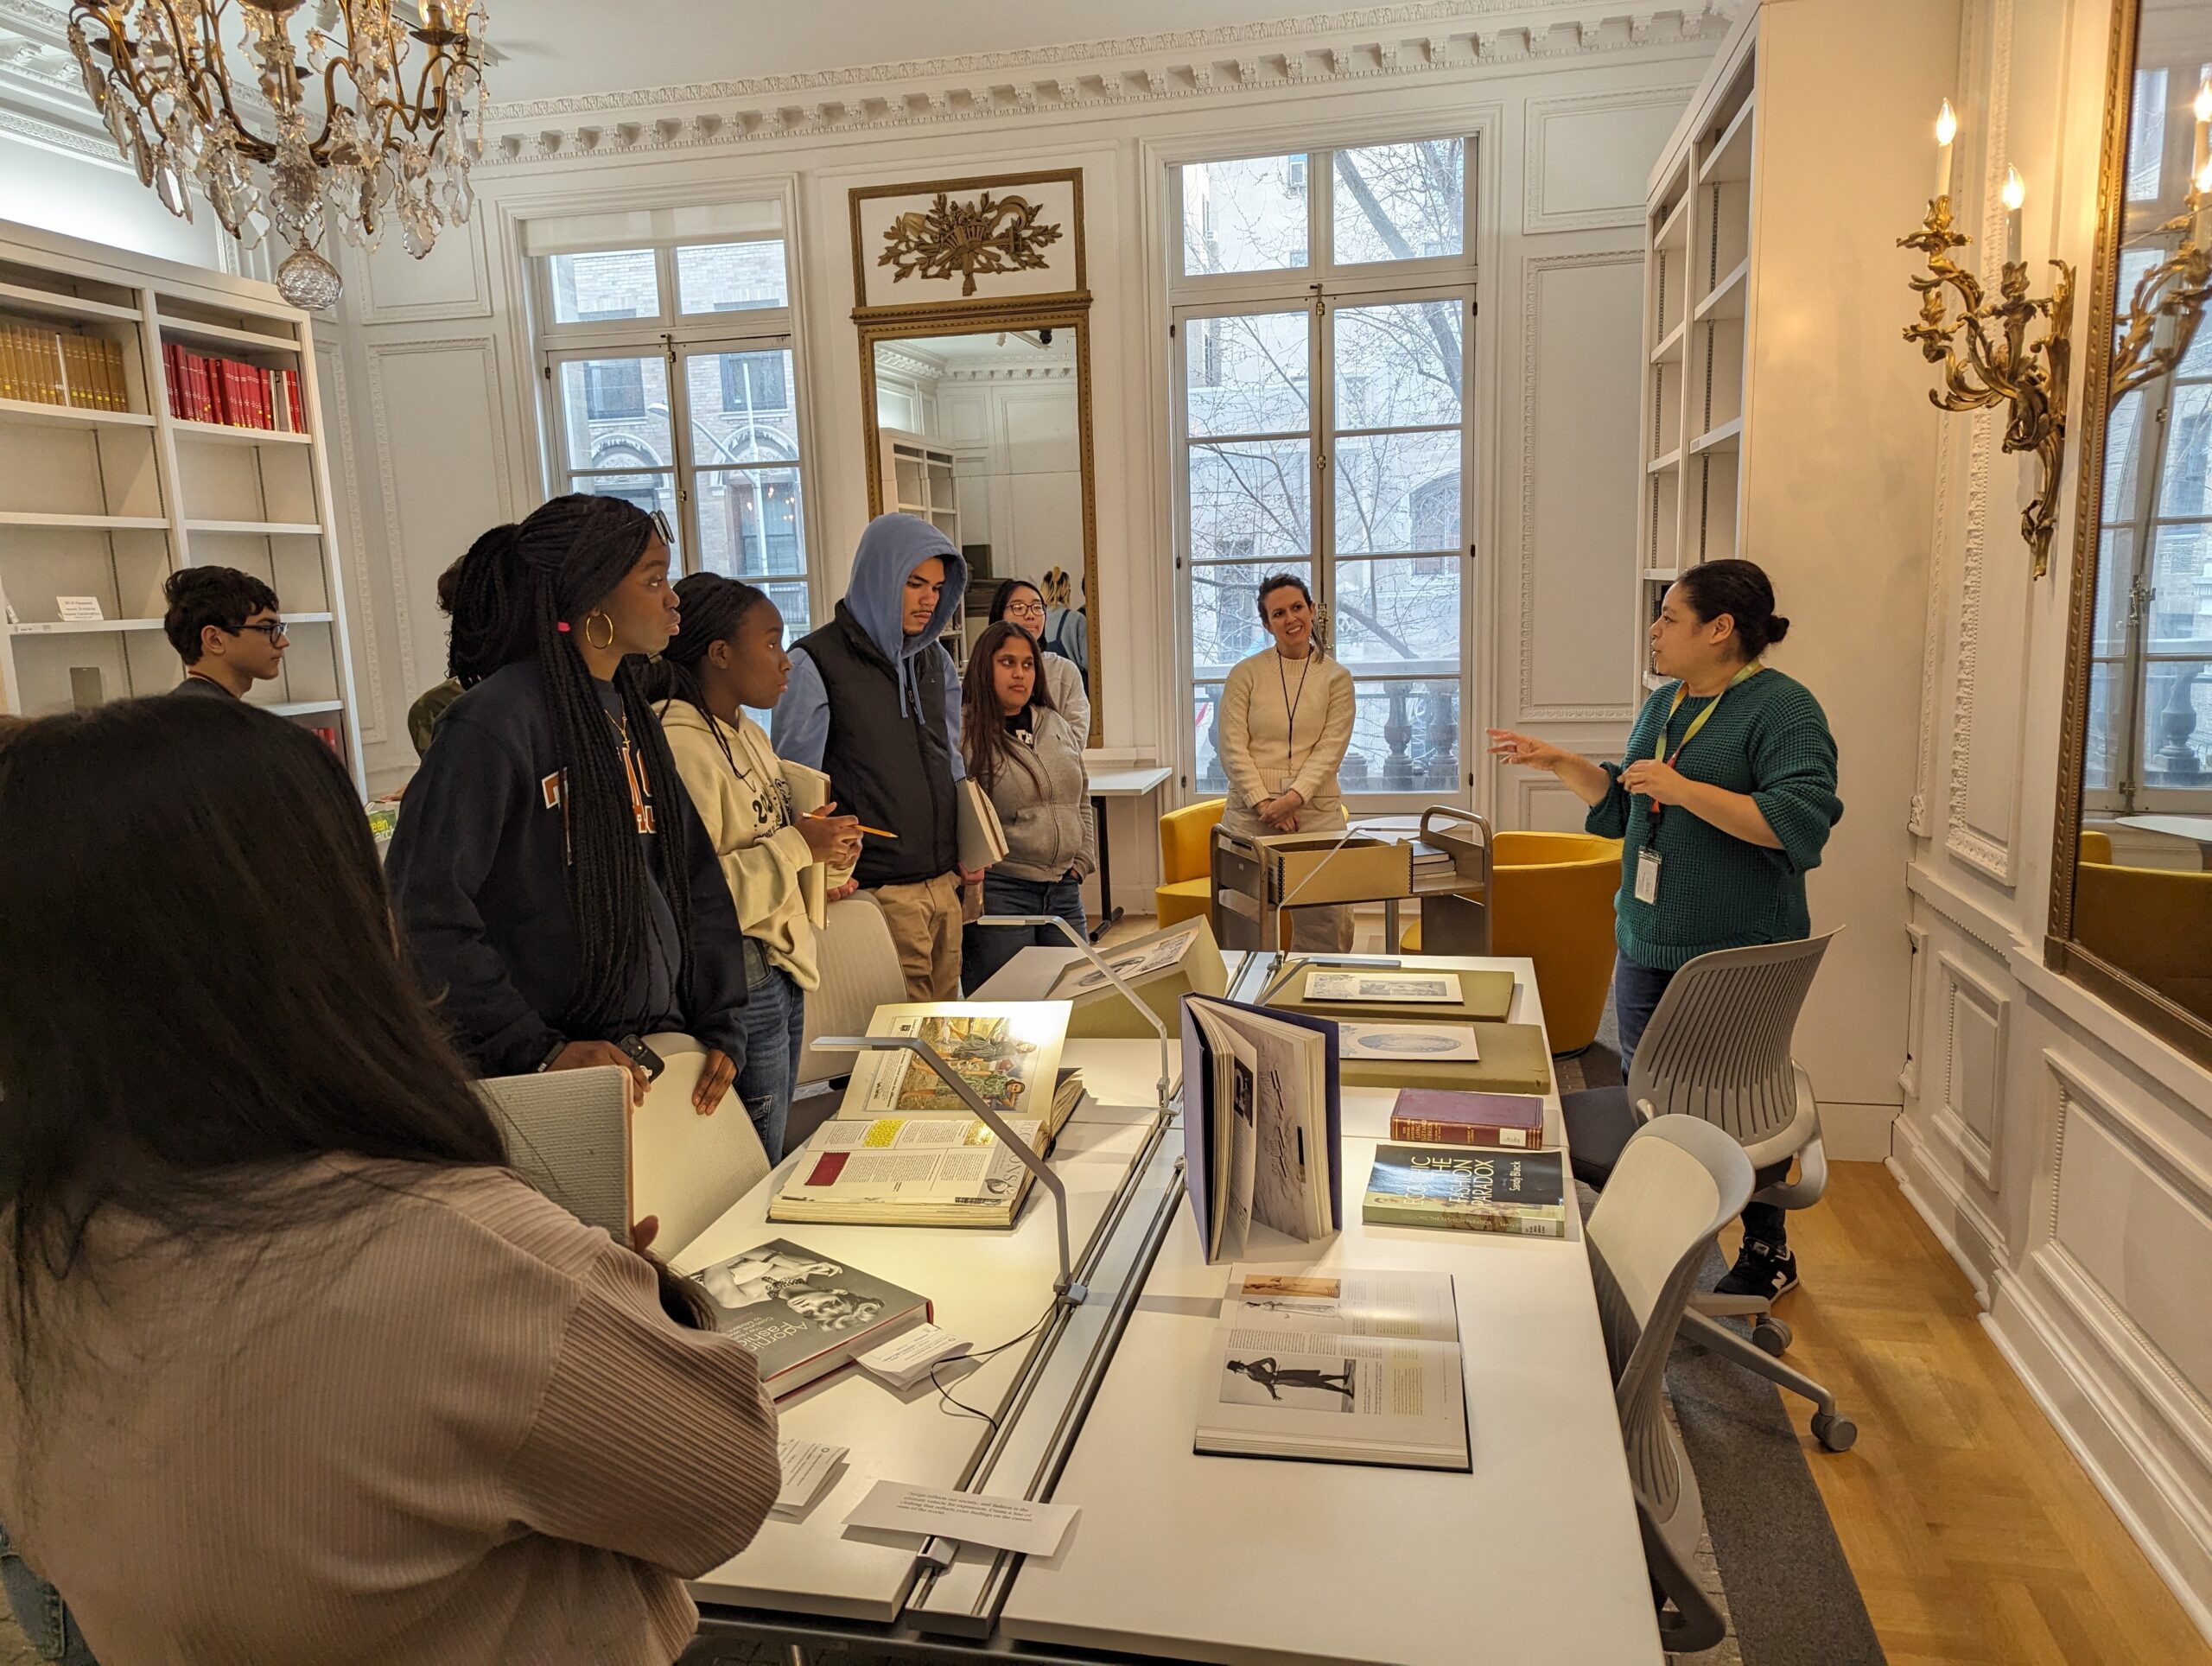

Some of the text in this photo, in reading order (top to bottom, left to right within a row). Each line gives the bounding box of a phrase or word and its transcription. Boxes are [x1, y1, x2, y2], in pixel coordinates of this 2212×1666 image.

[1448, 1159, 1473, 1203] FASHION
[1471, 1159, 1495, 1206] PARADOX
[1509, 1160, 1523, 1192] Sandy Black
[749, 1321, 808, 1351] Adornin
